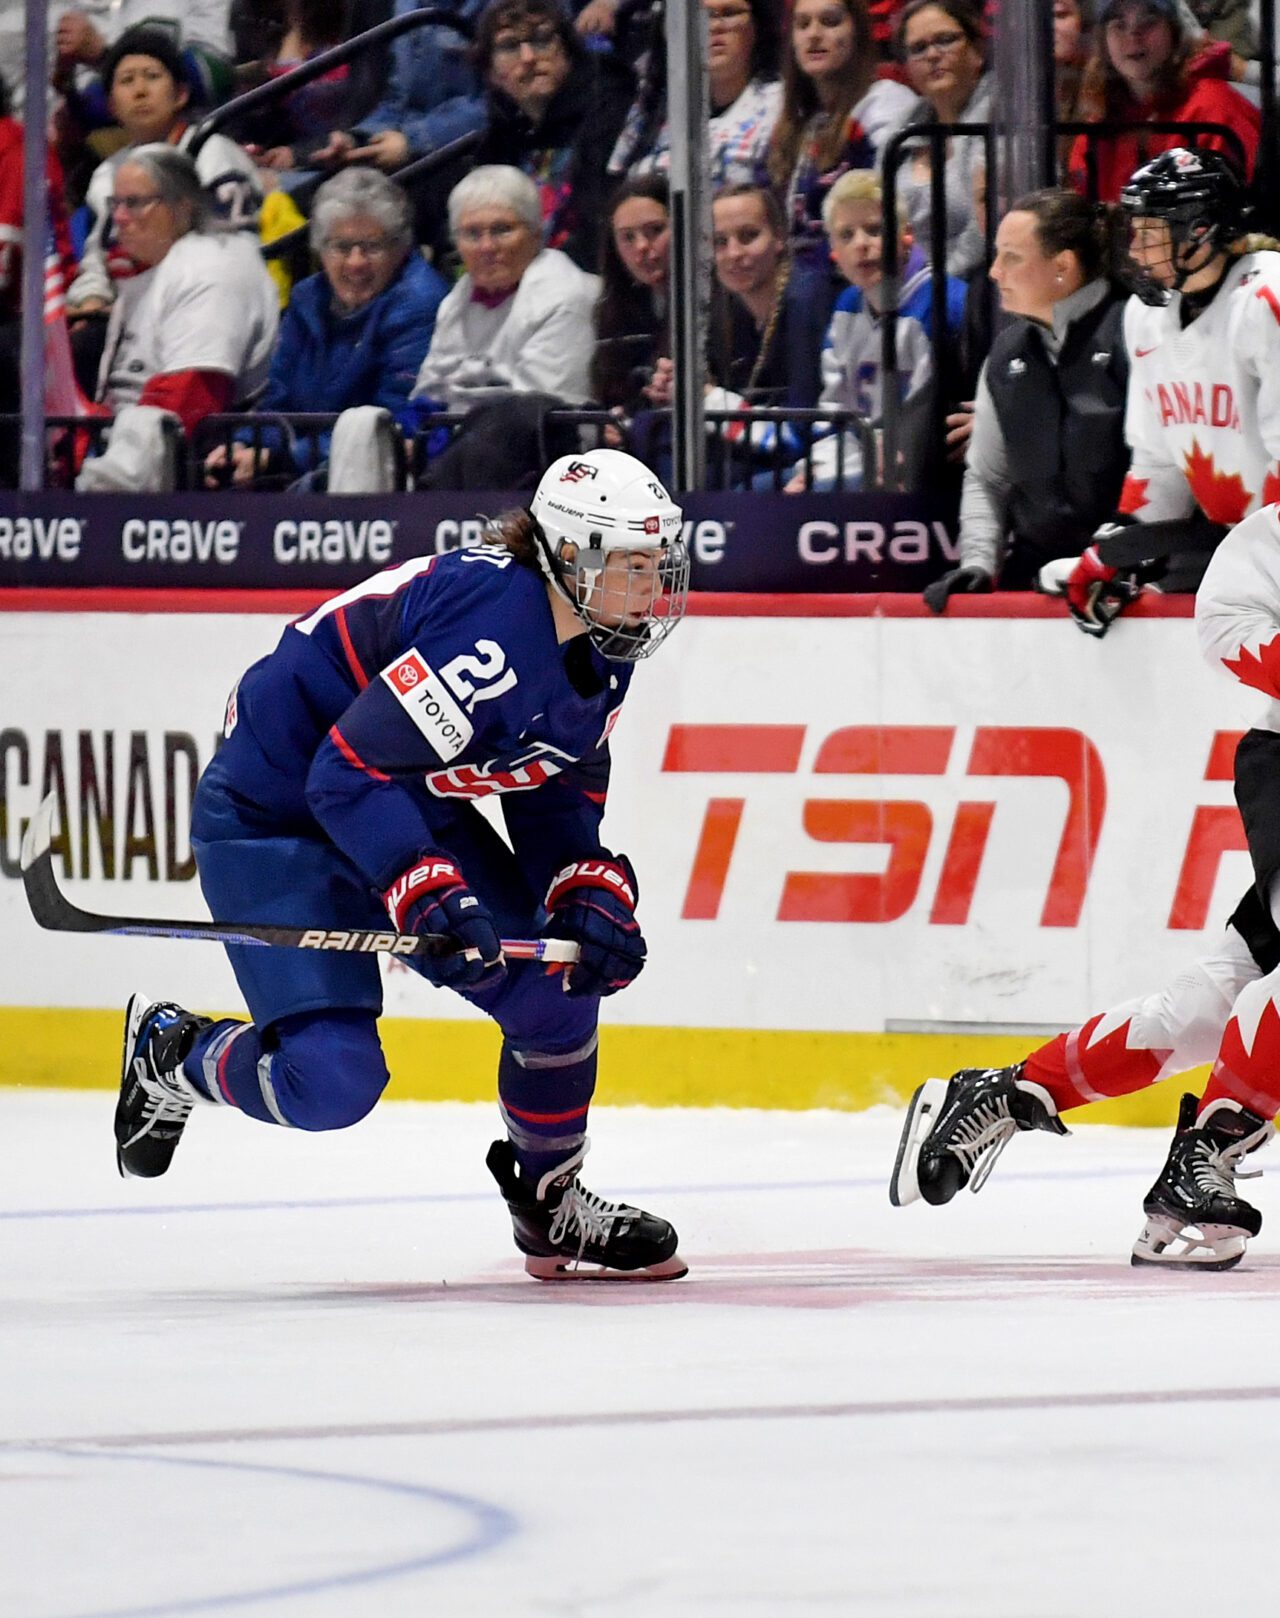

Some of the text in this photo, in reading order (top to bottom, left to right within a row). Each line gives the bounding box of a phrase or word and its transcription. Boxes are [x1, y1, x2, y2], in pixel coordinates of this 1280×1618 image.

[1145, 380, 1242, 434] ANAD
[546, 500, 585, 519] BAUER
[439, 638, 518, 714] 21
[417, 689, 466, 752] TOYOTA
[0, 727, 224, 882] CANAD
[660, 724, 1107, 928] TSN
[553, 1173, 571, 1188] 21
